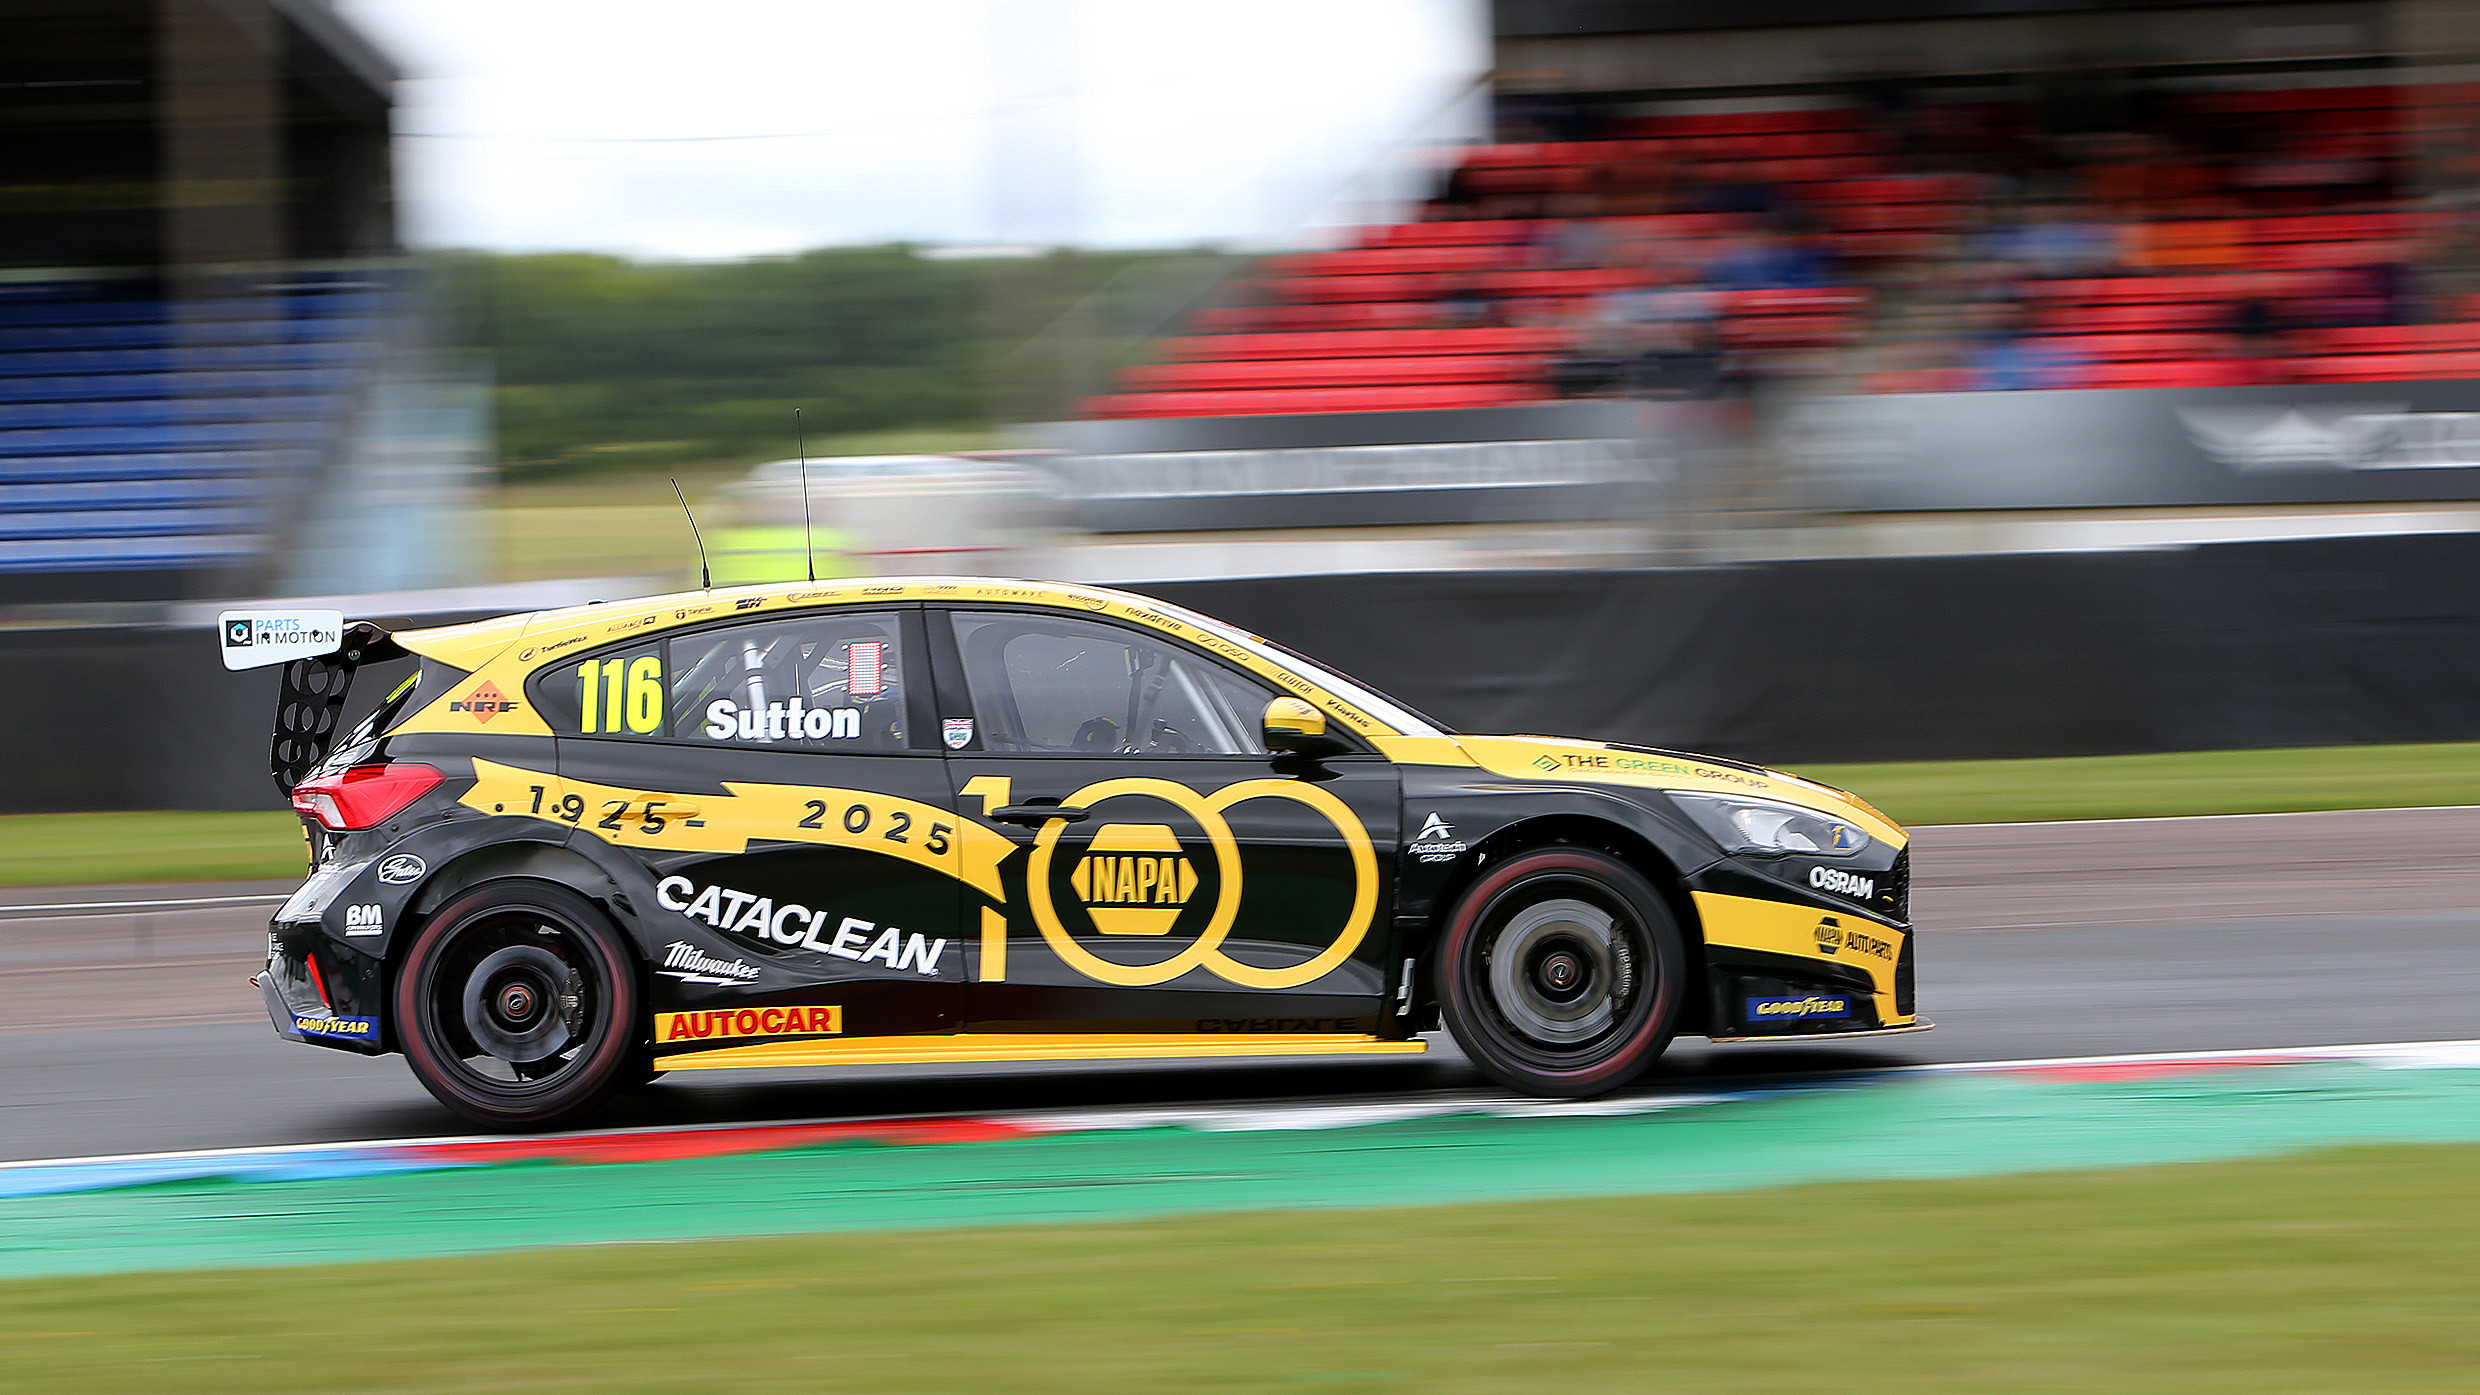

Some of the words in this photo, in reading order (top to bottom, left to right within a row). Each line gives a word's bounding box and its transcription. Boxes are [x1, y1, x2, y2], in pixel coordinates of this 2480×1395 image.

[256, 619, 300, 632] PARTS
[275, 630, 336, 644] MOTION
[449, 701, 520, 713] NRF
[577, 656, 663, 734] 116
[705, 697, 861, 740] Sutton
[1563, 754, 1609, 768] THE
[1616, 758, 1690, 775] GREEN
[1694, 768, 1769, 789] GROUP
[799, 799, 955, 856] 2025
[1093, 856, 1180, 905] NAPA
[1809, 865, 1874, 900] OSRAM
[346, 904, 383, 926] BM
[655, 875, 948, 976] CATACLEAN
[664, 940, 761, 980] Milwaukee
[668, 1007, 832, 1041] AUTOCAR
[1756, 995, 1845, 1018] GOODYEAR
[295, 1016, 371, 1035] GOODYEAR
